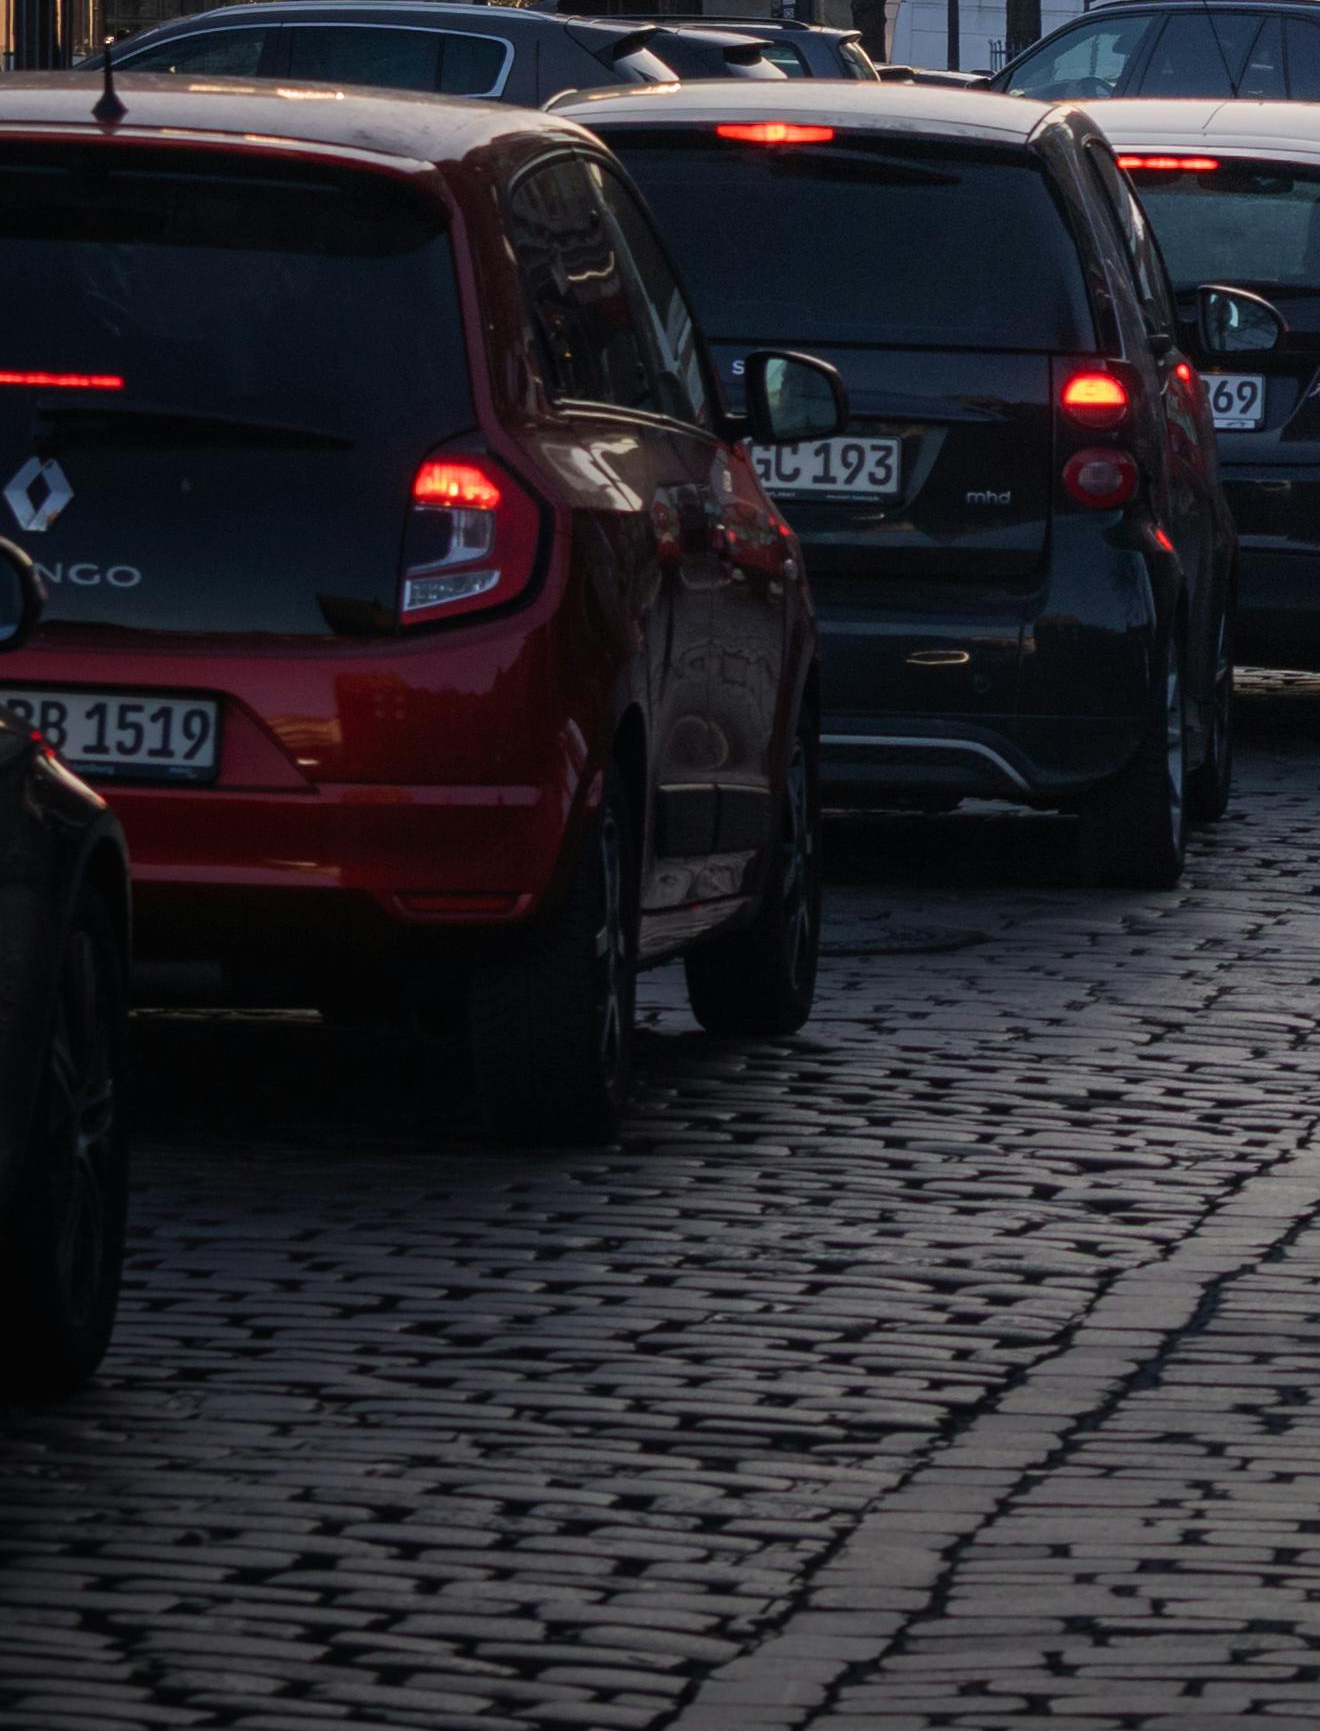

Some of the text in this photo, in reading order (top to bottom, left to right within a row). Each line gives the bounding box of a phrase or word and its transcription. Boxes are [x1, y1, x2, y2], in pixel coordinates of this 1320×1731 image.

[812, 443, 893, 485] 193
[966, 490, 1011, 505] mhd
[83, 702, 210, 760] 1519
